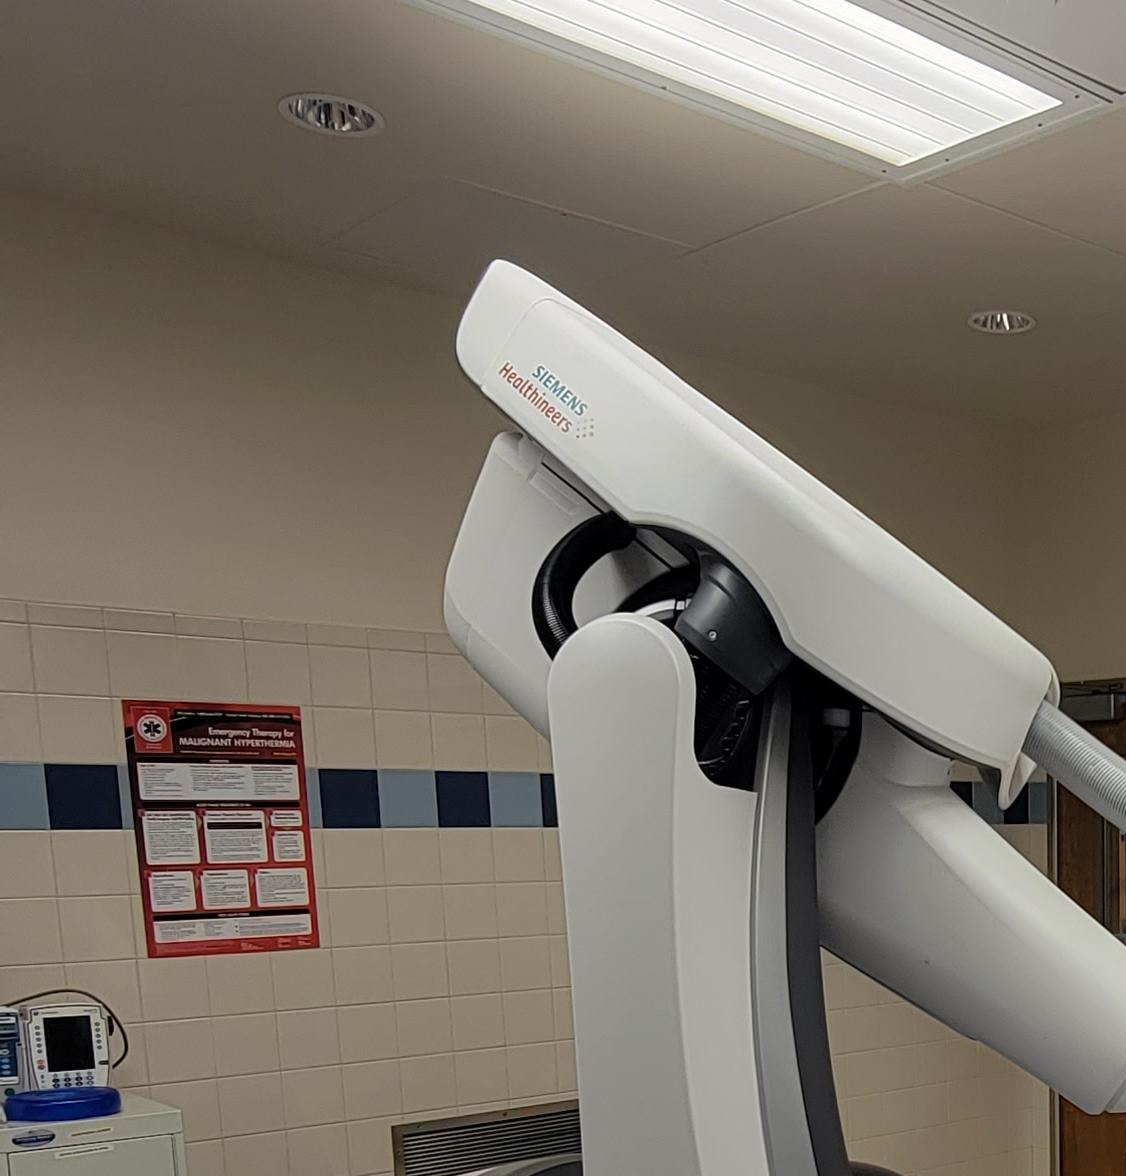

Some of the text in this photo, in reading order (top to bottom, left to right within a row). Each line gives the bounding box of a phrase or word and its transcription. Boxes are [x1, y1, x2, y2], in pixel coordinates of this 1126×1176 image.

[498, 362, 573, 433] Healthineers
[532, 365, 588, 416] SIEMENS
[179, 737, 296, 748] MALIGNANT HYPERTHERMIA
[208, 727, 295, 739] Emergency Therapy for
